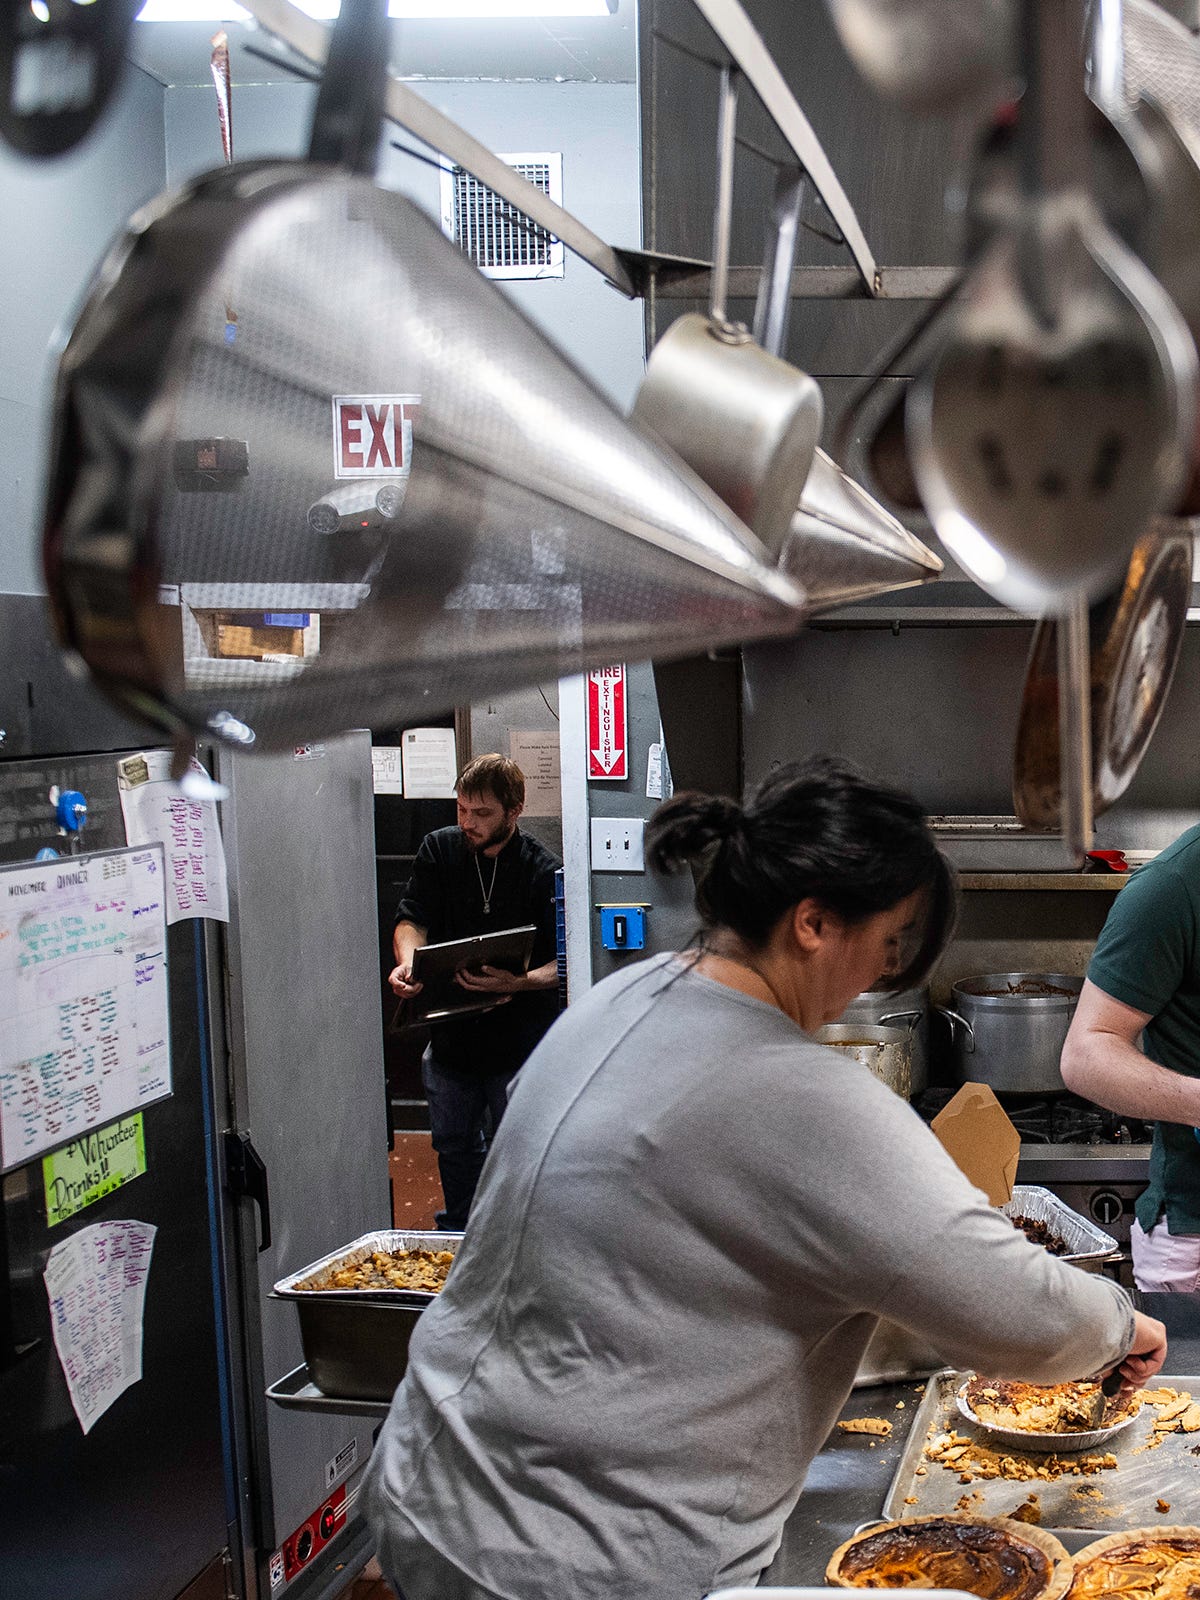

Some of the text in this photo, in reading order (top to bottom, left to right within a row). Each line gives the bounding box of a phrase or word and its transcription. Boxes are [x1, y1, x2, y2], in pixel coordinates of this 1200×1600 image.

[592, 666, 620, 678] FIRE
[603, 679, 611, 768] EXTINGUISHER
[8, 870, 89, 897] NOVEMBER DINNER
